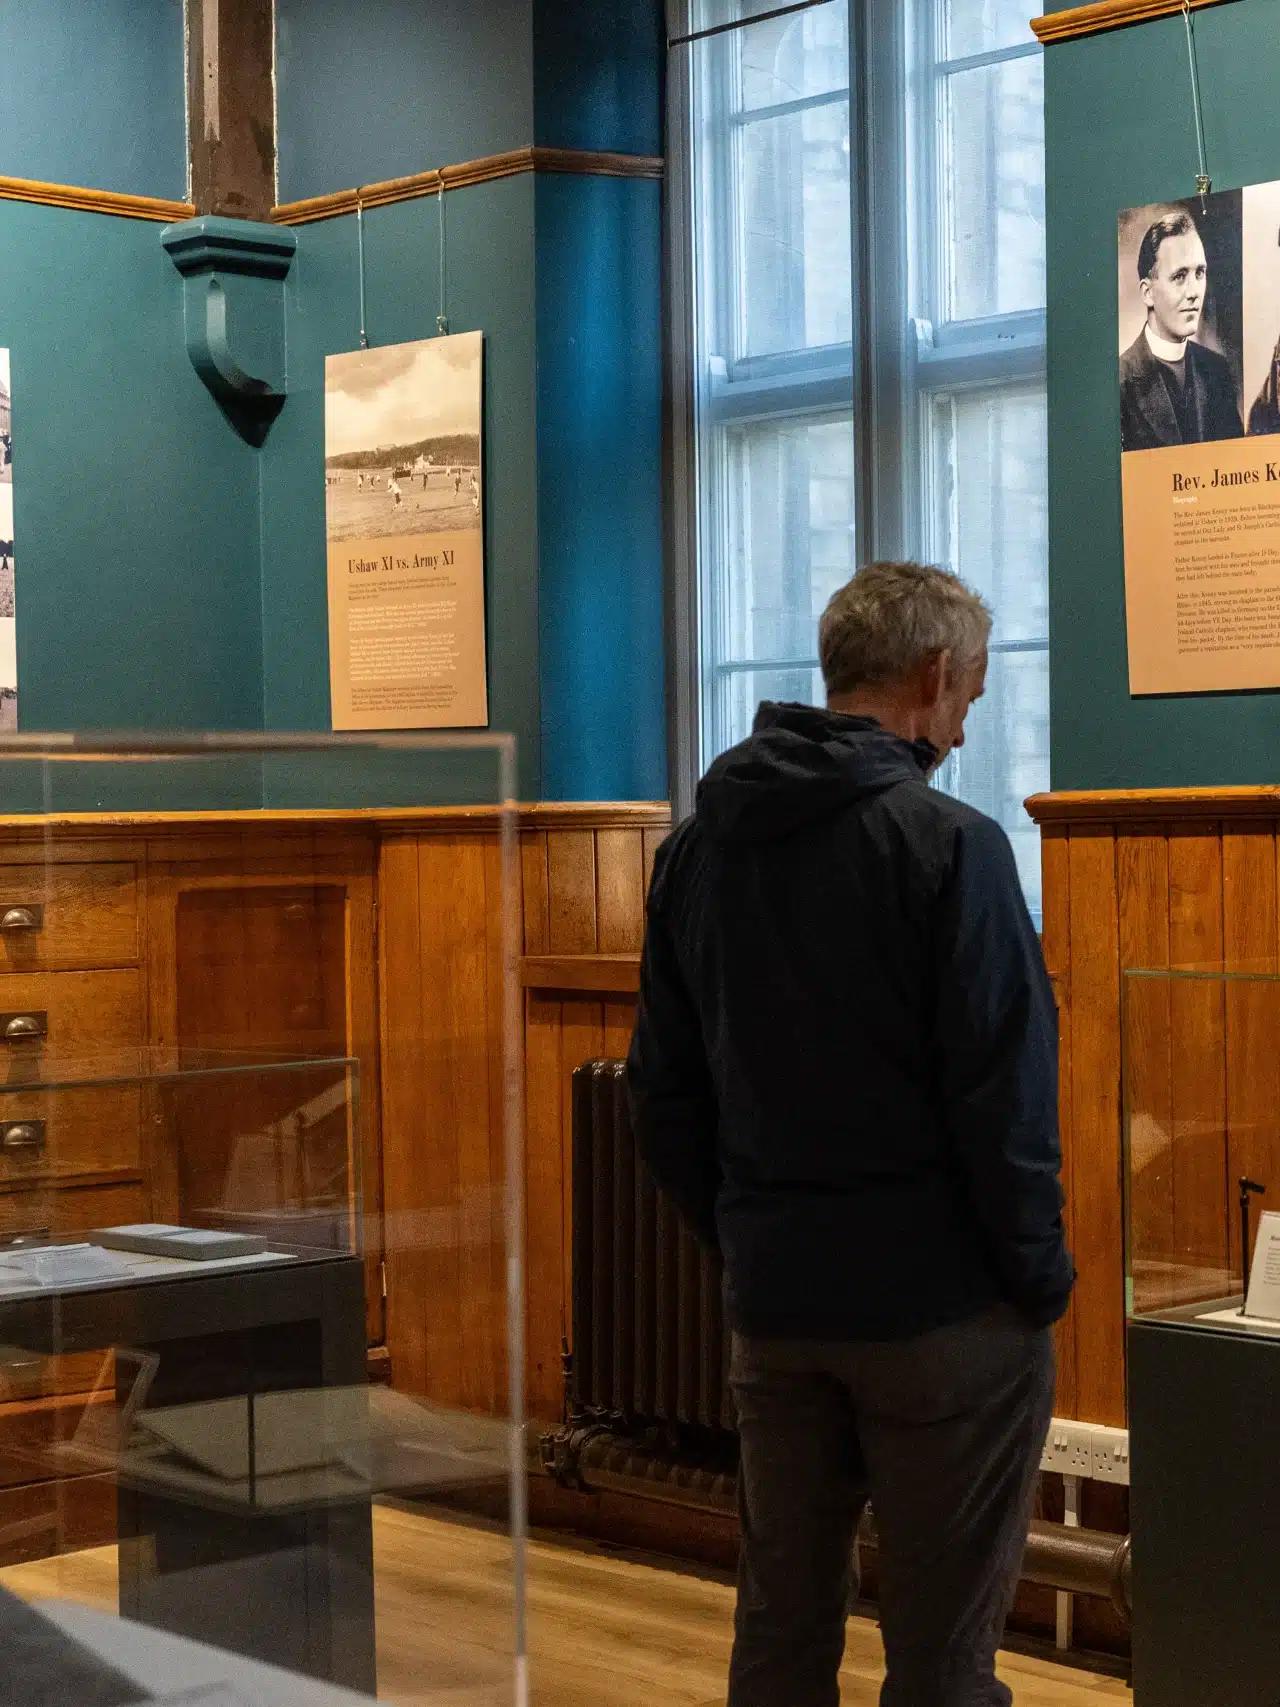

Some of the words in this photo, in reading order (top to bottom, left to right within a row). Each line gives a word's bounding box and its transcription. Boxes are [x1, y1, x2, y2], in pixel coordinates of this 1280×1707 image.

[1172, 473, 1206, 492] Rev.
[1211, 468, 1260, 488] James
[348, 558, 379, 574] Ushaw
[381, 555, 394, 571] XI
[396, 558, 410, 569] vs.
[412, 553, 439, 569] Army
[442, 550, 455, 565] XI
